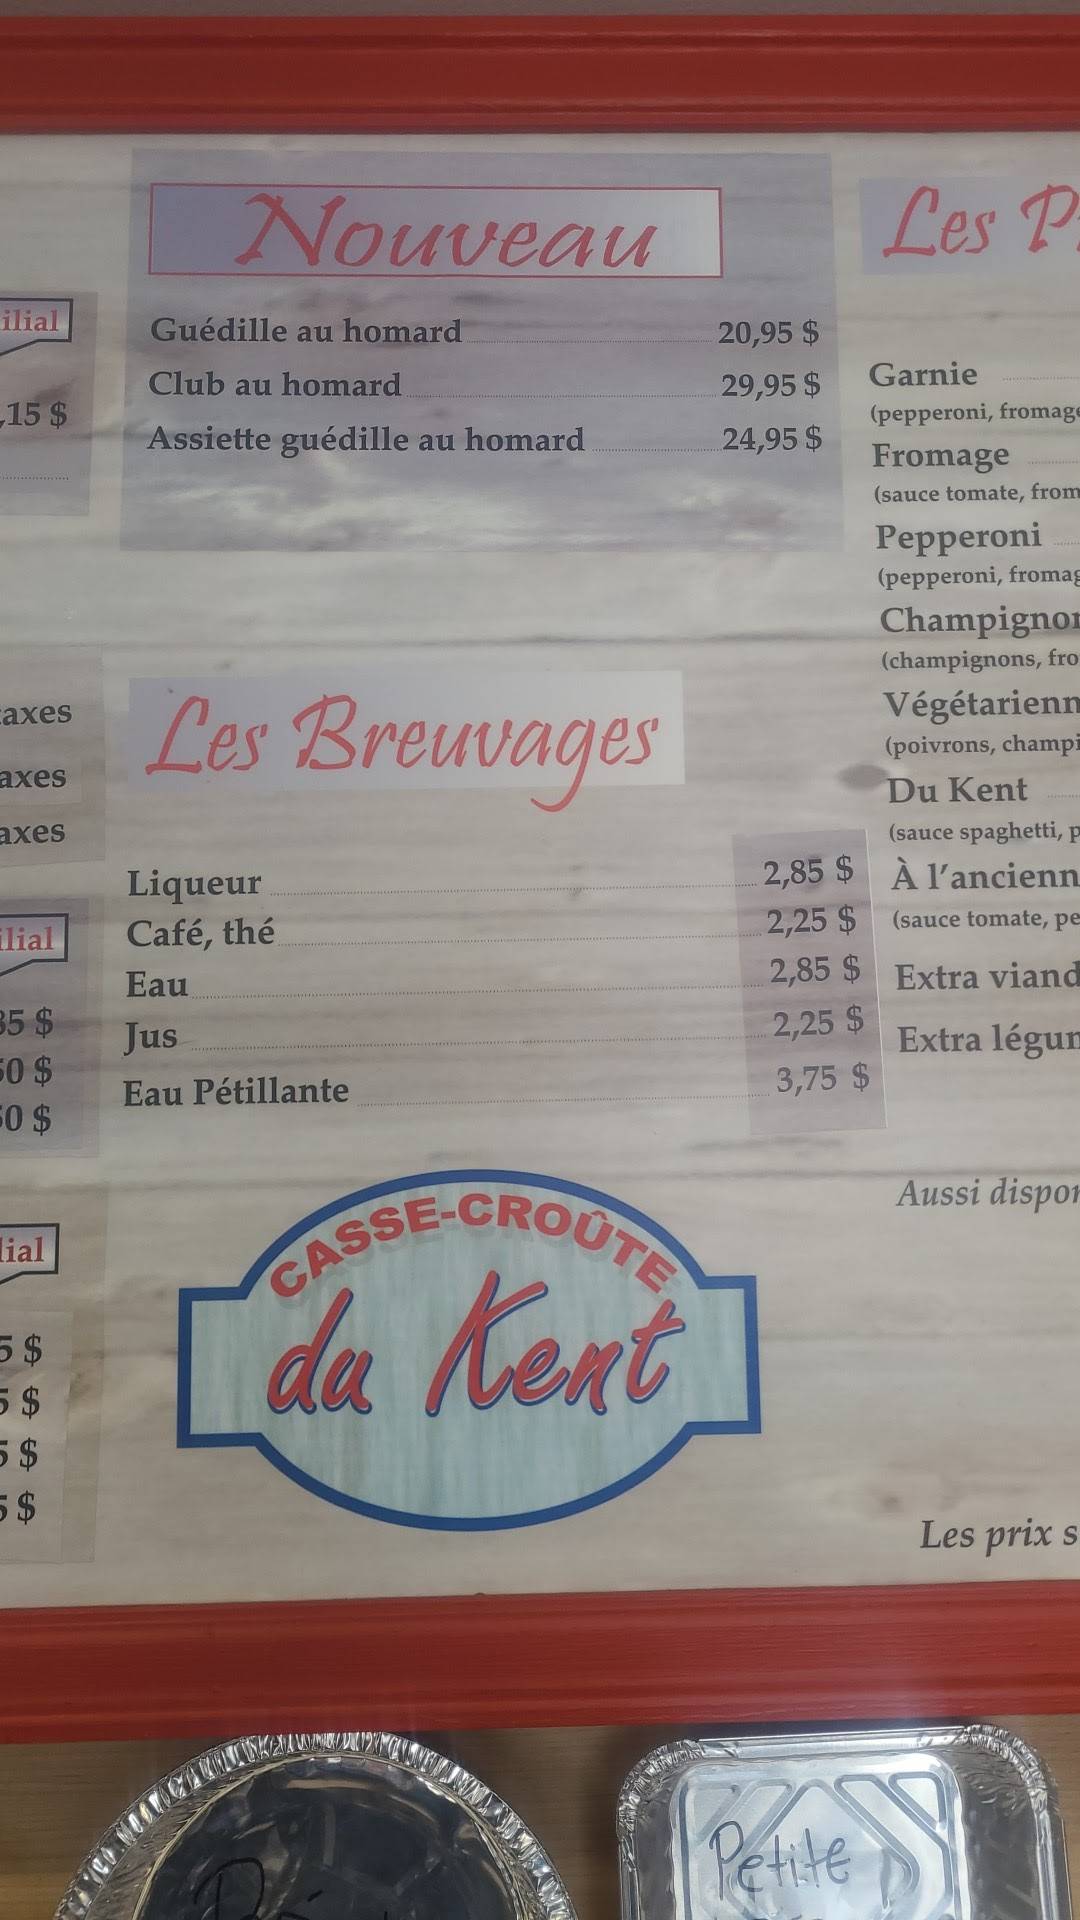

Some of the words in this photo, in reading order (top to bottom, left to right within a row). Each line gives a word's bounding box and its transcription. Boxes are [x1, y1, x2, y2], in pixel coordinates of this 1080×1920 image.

[235, 193, 656, 267] Nouveau
[883, 186, 995, 257] Les
[1020, 184, 1080, 253] P
[151, 317, 287, 342] Guédille
[297, 326, 333, 342] au
[343, 318, 462, 344] homard
[719, 322, 792, 348] 20,95
[803, 319, 819, 346] $
[149, 371, 224, 395] Club
[236, 379, 272, 396] au
[282, 372, 402, 396] homard
[722, 374, 796, 401] 29,95
[804, 371, 820, 399] $
[870, 361, 977, 386] Garnie
[51, 401, 67, 429] $
[871, 405, 993, 427] (pepperoni,
[147, 426, 271, 450] Assiette
[281, 426, 408, 458] guédille
[419, 434, 455, 451] au
[464, 427, 585, 451] homard
[723, 427, 797, 455] 24,95
[806, 424, 822, 452] $
[872, 443, 1009, 474] Fromage
[875, 486, 939, 504] (sauce
[946, 485, 1024, 503] tomate,
[876, 522, 1042, 557] Pepperoni
[879, 566, 1002, 590] (pepperoni,
[882, 651, 1041, 673] (champignons,
[1048, 648, 1078, 666] fro
[883, 689, 1080, 725] Végétarienn
[145, 696, 267, 775] Les
[289, 694, 658, 812] Breuvages
[886, 736, 995, 759] (poivrons,
[886, 778, 939, 803] Du
[948, 777, 1028, 802] Kent
[890, 824, 953, 842] (sauce
[960, 822, 1062, 845] spaghetti,
[128, 870, 261, 904] Liqueur
[765, 859, 823, 889] 2,85
[836, 854, 853, 884] $
[891, 857, 918, 890] À
[127, 918, 212, 951] Café,
[223, 917, 274, 945] thé
[768, 907, 827, 938] 2,25
[838, 904, 856, 935] $
[893, 910, 960, 930] (sauce
[968, 910, 1048, 929] tomate,
[126, 971, 188, 997] Eau
[771, 956, 830, 987] 2,85
[843, 954, 860, 984] $
[895, 964, 979, 990] Extra
[989, 960, 1080, 988] viand
[35, 1007, 53, 1039] $
[124, 1022, 177, 1056] Jus
[774, 1010, 833, 1041] 2,25
[847, 1004, 863, 1035] $
[897, 1027, 982, 1052] Extra
[0, 1058, 24, 1084] 0
[35, 1055, 52, 1087] $
[123, 1080, 183, 1106] Eau
[193, 1077, 348, 1105] Pétillante
[777, 1065, 836, 1096] 3,75
[852, 1062, 869, 1092] $
[0, 1105, 22, 1131] 0
[33, 1104, 51, 1136] $
[896, 1178, 979, 1206] Aussi
[269, 1192, 679, 1299] CASSE-CROÛTE
[24, 1334, 42, 1367] $
[267, 1287, 373, 1415] du
[424, 1269, 686, 1418] Kent
[22, 1386, 39, 1419] $
[20, 1437, 37, 1472] $
[18, 1490, 35, 1525] $
[920, 1520, 974, 1548] Les
[986, 1518, 1052, 1557] prix
[1063, 1526, 1077, 1545] s
[708, 1820, 851, 1901] Petite
